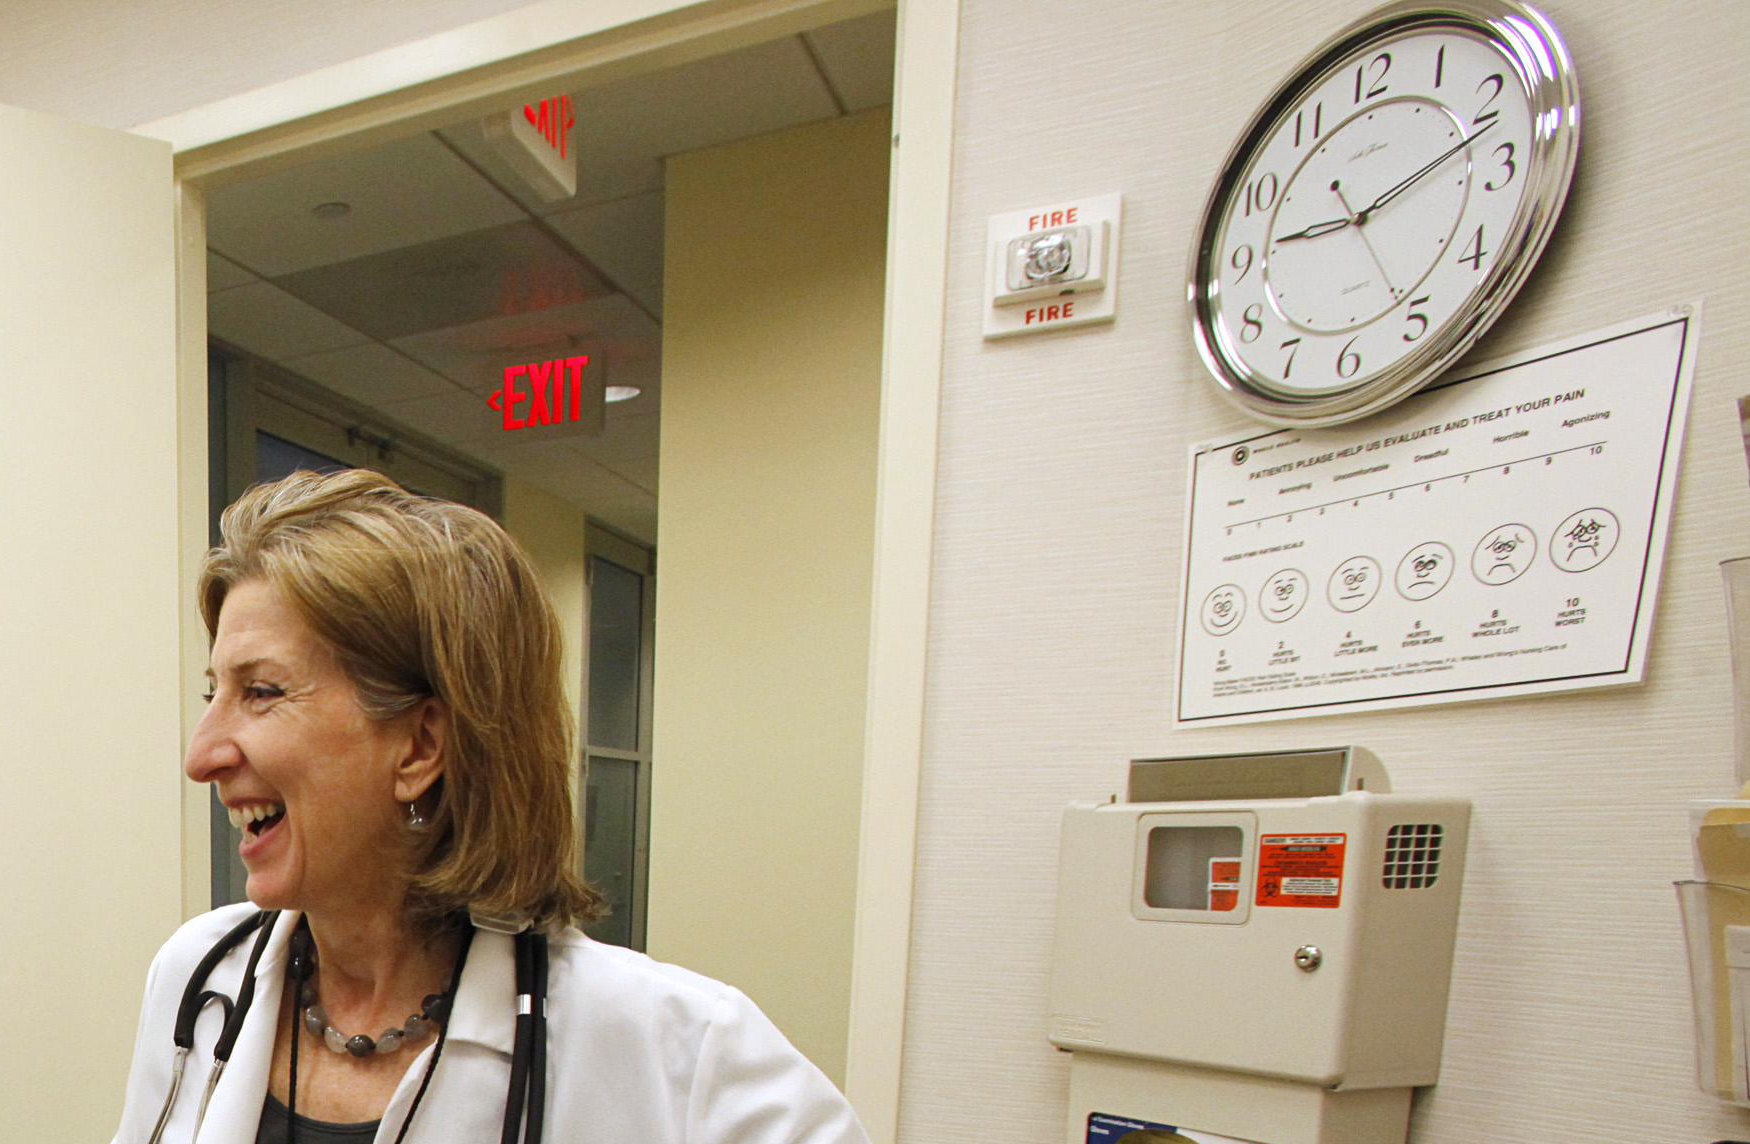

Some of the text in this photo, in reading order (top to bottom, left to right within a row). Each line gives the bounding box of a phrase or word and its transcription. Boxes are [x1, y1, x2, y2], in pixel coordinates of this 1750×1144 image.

[1354, 52, 1392, 104] 12
[1435, 43, 1445, 89] 1
[1473, 73, 1504, 125] 2
[1295, 101, 1322, 148] 11
[1484, 142, 1516, 191] 3
[1245, 172, 1278, 217] 10
[1029, 207, 1078, 231] FIRE
[1457, 223, 1488, 271] 4
[1231, 244, 1253, 286] 9
[1025, 302, 1074, 325] FIRE
[1240, 303, 1263, 343] 8
[1403, 294, 1431, 342] 5
[1280, 338, 1301, 380] 7
[1336, 335, 1361, 378] 6
[503, 355, 589, 431] EXIT
[1249, 388, 1586, 481] PATIENTS PLEASE HELP US EVALUATE AND TREAT YOUR PAIN
[1278, 482, 1313, 495] Annoying
[1333, 464, 1390, 482] Uncomfortable
[1413, 448, 1450, 463] Dreadful
[1492, 429, 1530, 444] Horrible
[1561, 410, 1611, 428] Agonizing
[1388, 491, 1394, 500] 5
[1424, 483, 1431, 492] 6
[1463, 475, 1470, 484] 7
[1503, 466, 1510, 475] 8
[1545, 456, 1552, 466] 9
[1590, 445, 1603, 456] 10
[1283, 540, 1305, 550] SCALE
[1491, 609, 1499, 619] 8
[1557, 608, 1586, 618] HURTS
[1565, 597, 1580, 608] 10
[1414, 620, 1421, 629] 6
[1472, 625, 1520, 638] WHOLE LOT
[1479, 619, 1508, 629] HURTS
[1555, 617, 1586, 627] WORST
[1278, 641, 1284, 650] 2
[1339, 639, 1363, 648] HURTS
[1401, 635, 1445, 648] EVEN MORE
[1406, 630, 1431, 639] HURTS
[1268, 657, 1289, 666] LITTLE
[1273, 650, 1294, 658] HURTS
[1334, 645, 1379, 657] LITTLE MORE
